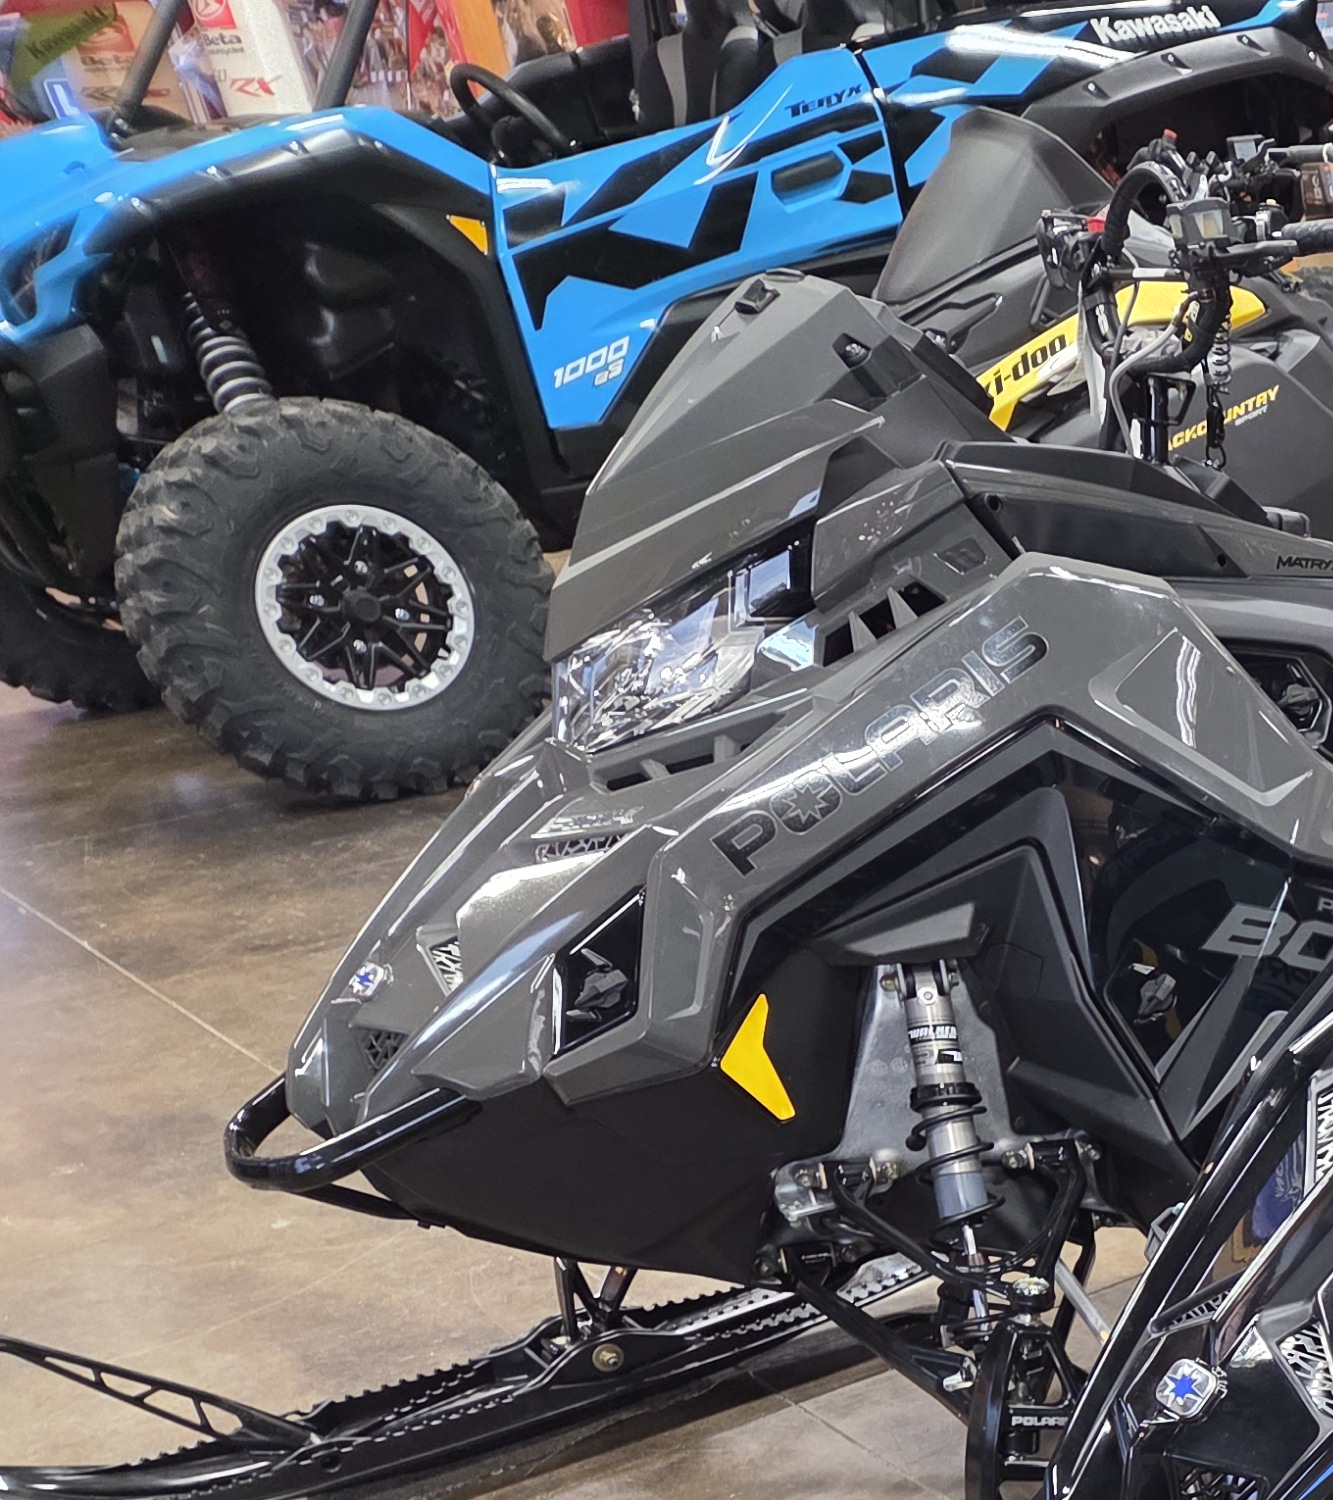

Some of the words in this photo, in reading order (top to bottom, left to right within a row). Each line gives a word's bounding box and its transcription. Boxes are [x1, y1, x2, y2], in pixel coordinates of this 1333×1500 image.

[204, 34, 243, 46] Beta
[1090, 5, 1221, 44] Kawasaki
[553, 335, 629, 388] 1000
[709, 615, 1050, 878] POLARIS
